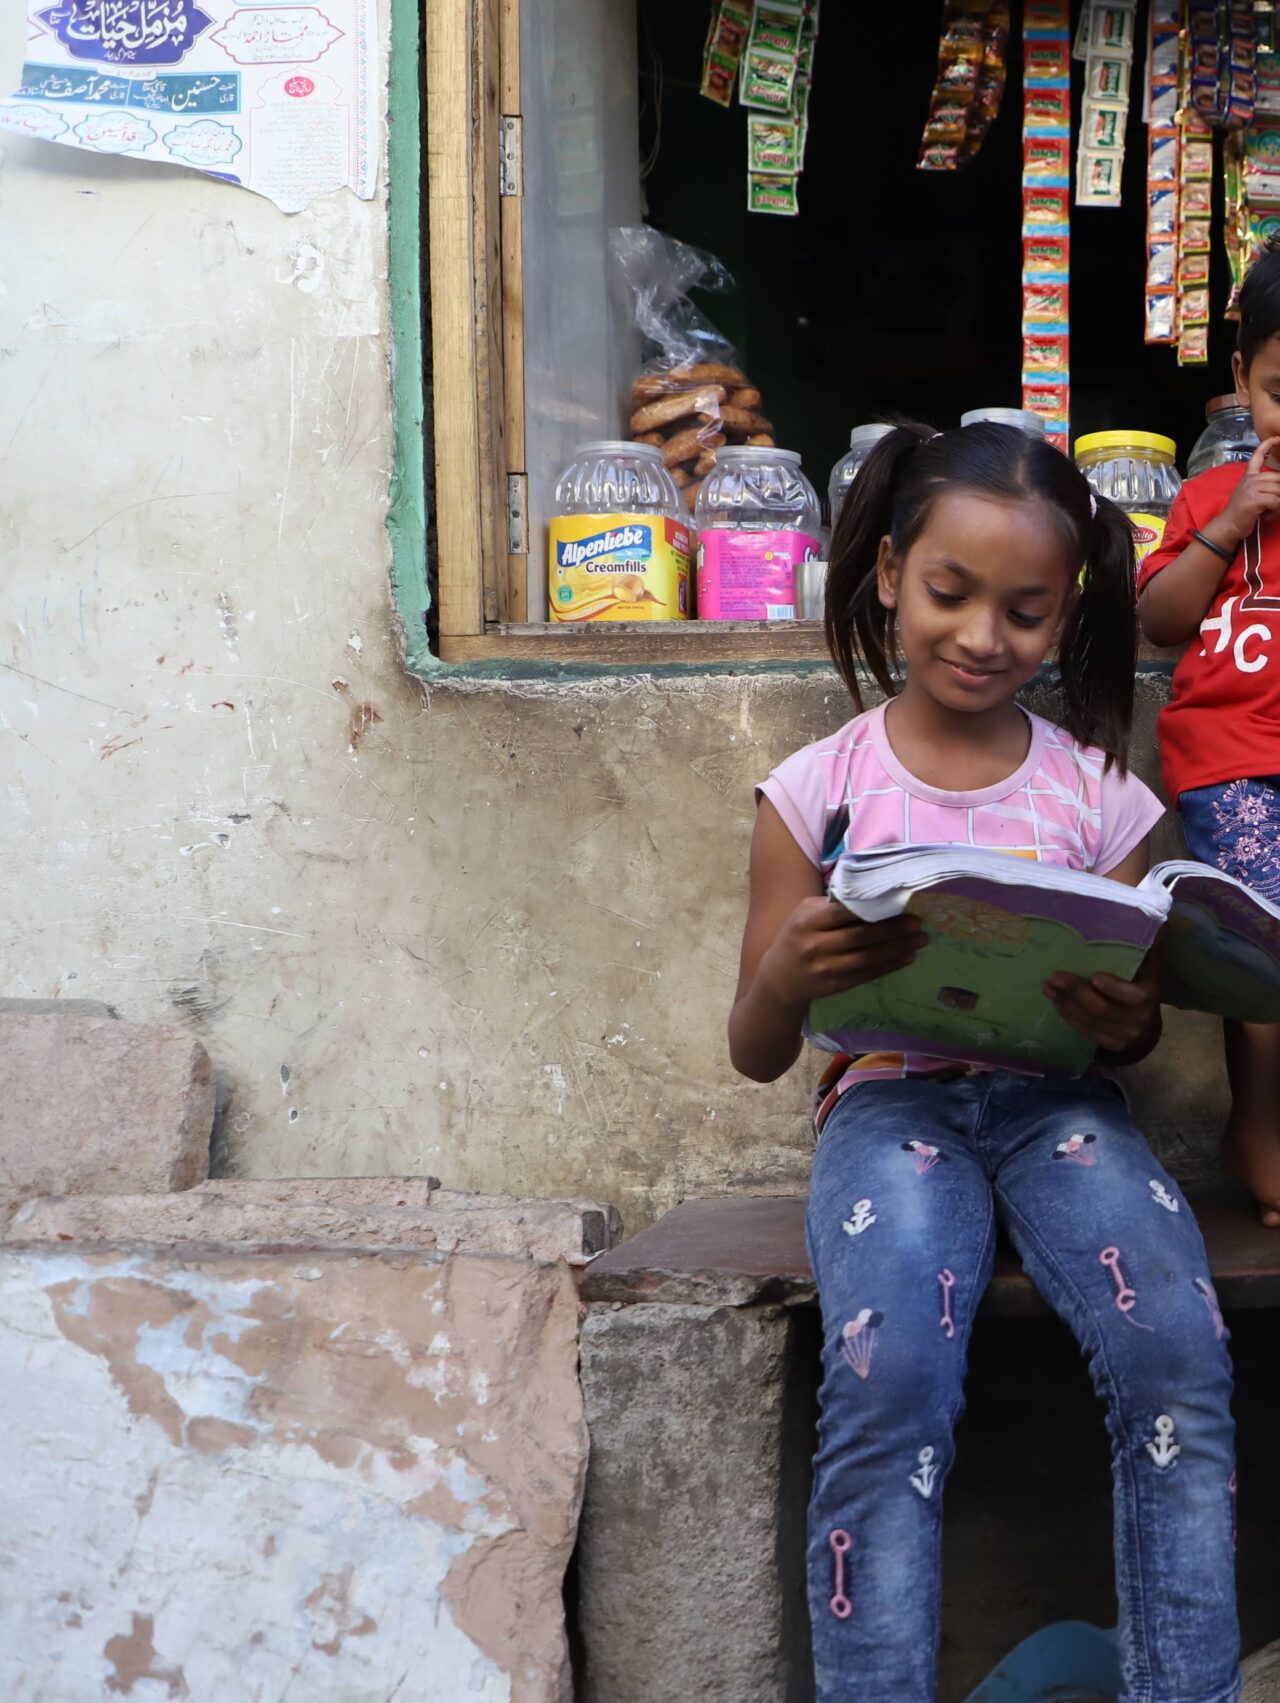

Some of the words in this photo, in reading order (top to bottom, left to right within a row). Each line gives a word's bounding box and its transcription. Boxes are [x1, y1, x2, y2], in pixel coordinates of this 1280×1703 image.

[561, 527, 643, 568] Alpenliebe
[585, 560, 647, 573] Creamfills
[1233, 623, 1272, 673] C
